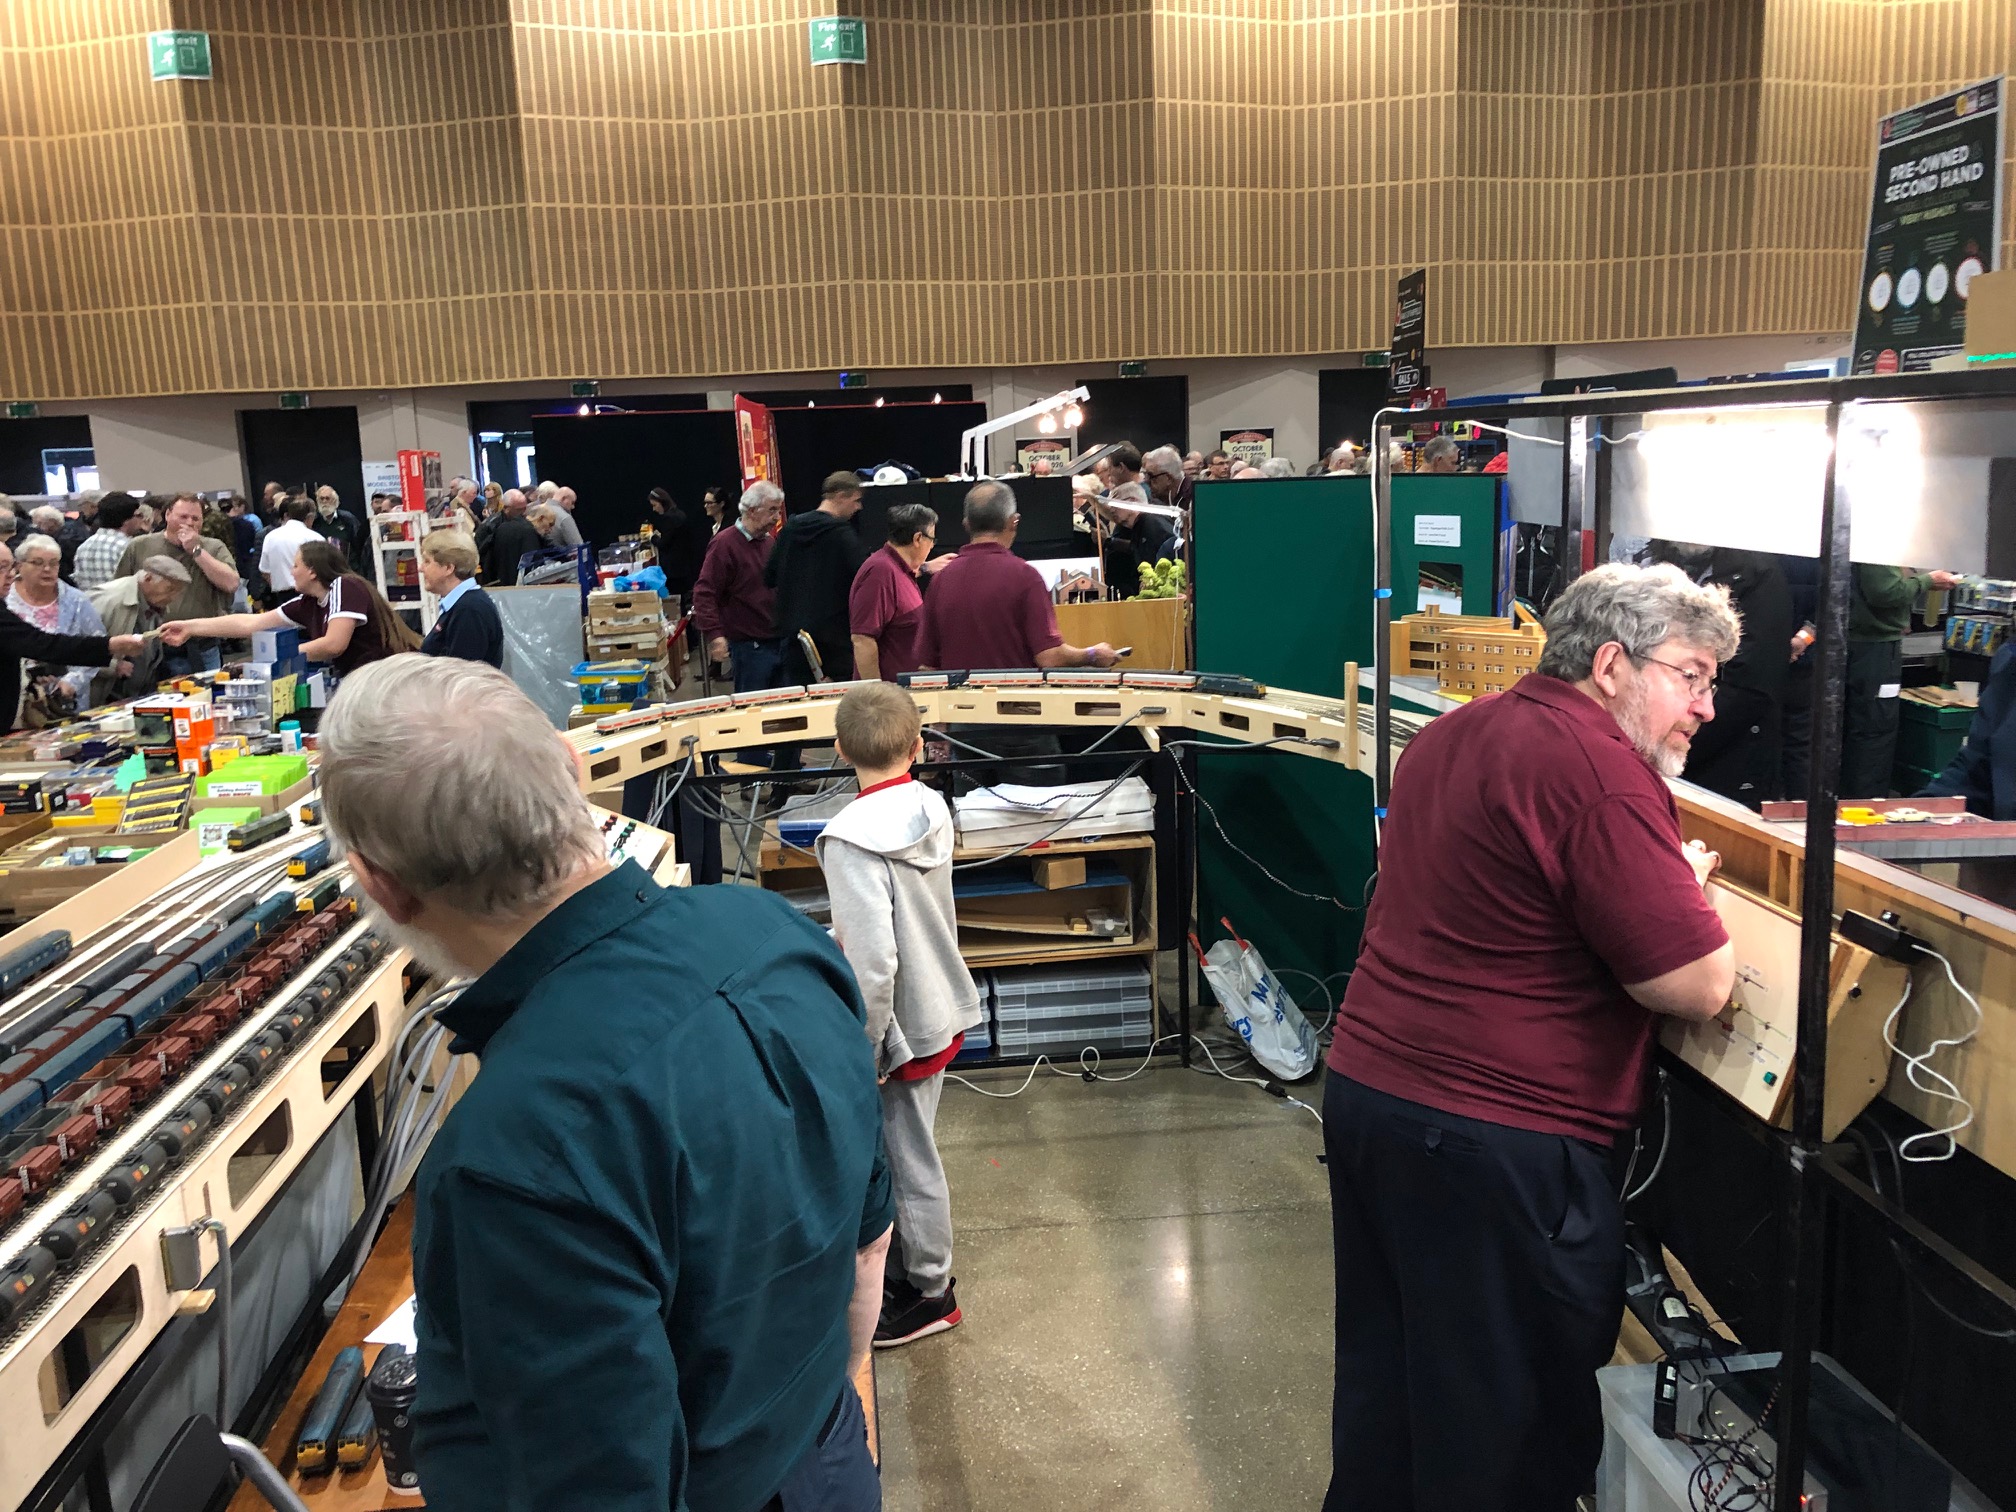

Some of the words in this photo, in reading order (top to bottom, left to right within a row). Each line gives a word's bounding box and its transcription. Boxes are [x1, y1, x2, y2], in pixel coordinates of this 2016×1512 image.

[818, 21, 837, 32] Fire
[838, 22, 856, 31] exit
[156, 36, 175, 46] Fire
[176, 36, 198, 46] exit
[1889, 145, 1970, 184] PRE-OWNED
[1884, 174, 1939, 203] SECOND
[1940, 162, 1984, 189] HAND
[1232, 445, 1264, 453] OCTOBER
[1028, 454, 1062, 462] OCTOBER
